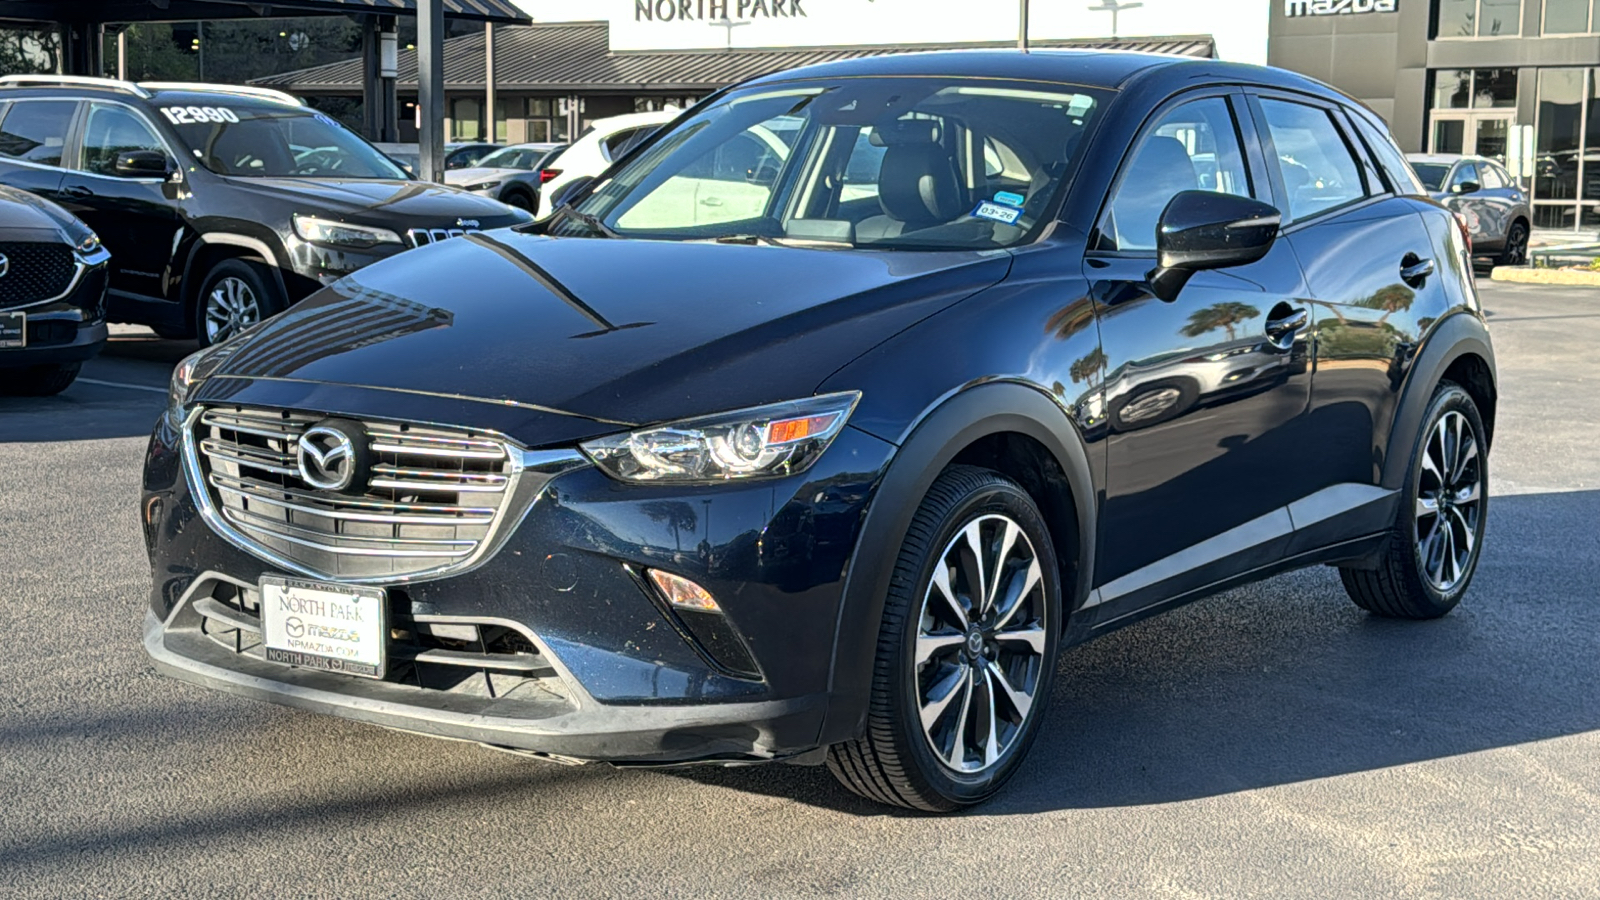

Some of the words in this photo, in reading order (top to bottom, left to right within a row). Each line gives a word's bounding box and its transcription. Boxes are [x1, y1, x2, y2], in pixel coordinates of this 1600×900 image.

[634, 0, 729, 22] NORTH
[736, 0, 808, 19] PARK
[1284, 0, 1398, 17] mazda
[160, 106, 240, 125] 12990
[279, 594, 325, 617] NORTH
[330, 602, 364, 622] PARK
[307, 624, 360, 642] mazda
[287, 639, 359, 657] NPMAZDACOM
[268, 650, 302, 664] NORTH
[303, 656, 330, 669] PARK
